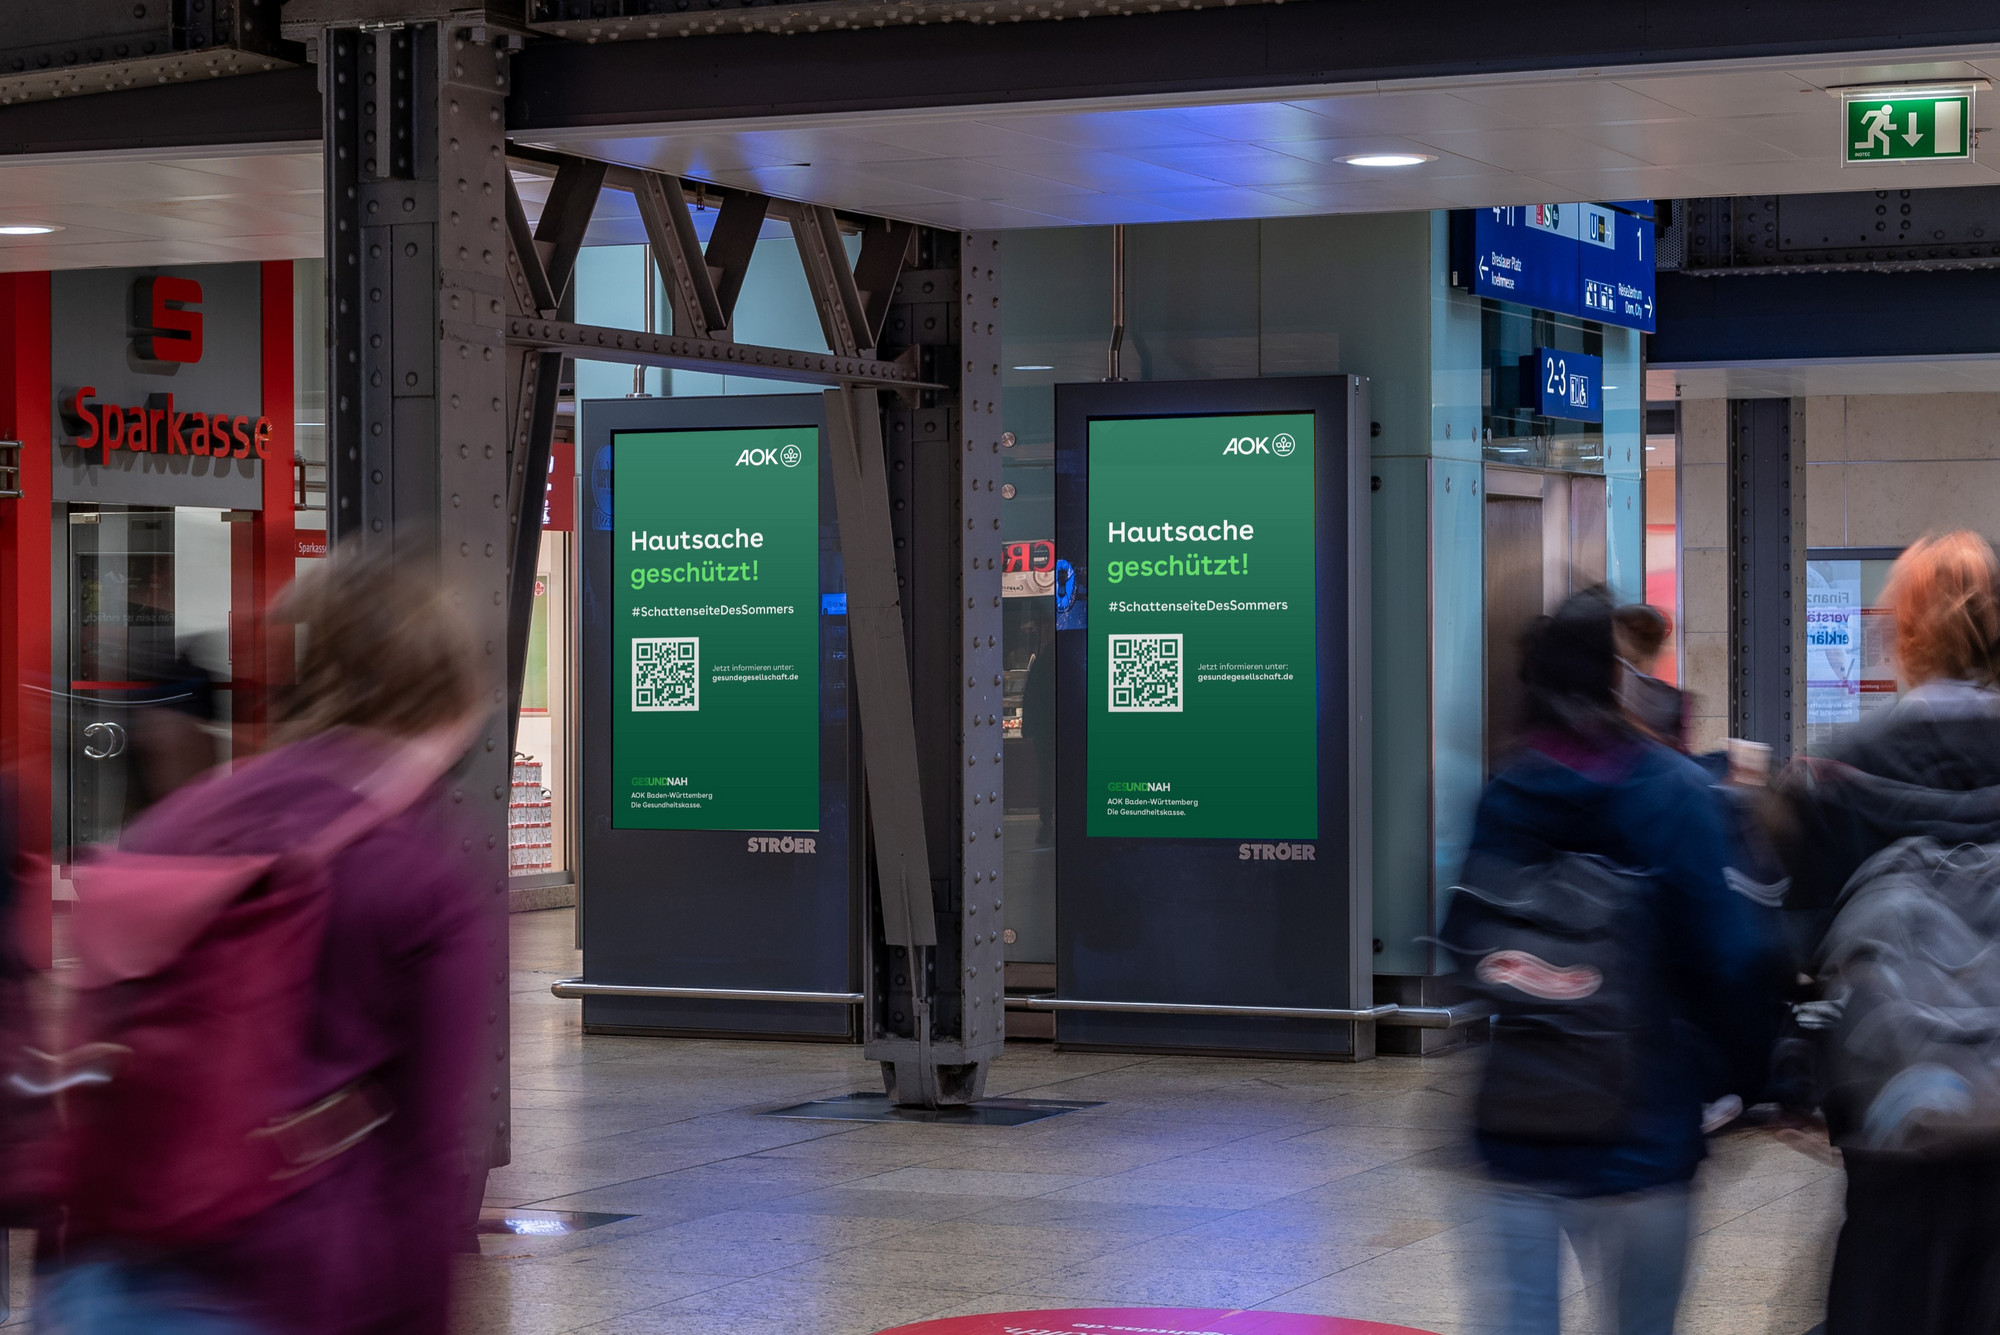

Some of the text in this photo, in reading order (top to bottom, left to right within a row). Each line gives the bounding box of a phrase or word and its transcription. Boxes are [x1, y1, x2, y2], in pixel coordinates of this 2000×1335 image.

[1591, 215, 1597, 239] U
[1637, 227, 1642, 262] 1
[1491, 251, 1522, 272] Breslauer Platz
[1635, 303, 1643, 319] City
[1546, 357, 1566, 396] 2-3
[75, 386, 273, 466] Sparkasse
[1222, 436, 1270, 456] AOK
[735, 448, 778, 466] AOK
[631, 528, 763, 551] Hautsache
[1108, 519, 1254, 543] Hautsache
[630, 560, 759, 590] geschützt!
[1107, 553, 1249, 584] geschützt!
[631, 604, 795, 617] #SchattenseiteDesSommers
[1108, 599, 1289, 612] #SchattenseiteDesSommers
[712, 664, 731, 672] Jetzt
[1197, 663, 1218, 671] Jetzt
[1219, 662, 1264, 670] informieren
[712, 673, 799, 683] gesundegesellschaft.de
[1197, 673, 1294, 683] gesundegesellschaft.de
[631, 777, 688, 786] GESUNDNAH
[1107, 782, 1171, 792] GESUNDNAH
[646, 791, 713, 801] Baden-Württemberg
[1107, 798, 1199, 807] AOK Baden-Württemberg
[630, 801, 702, 809] Die Gesundheitskasse.
[1107, 808, 1187, 816] Die Gesundheitskasse.
[747, 836, 817, 854] STRÖER
[1238, 842, 1316, 861] STRÖER
